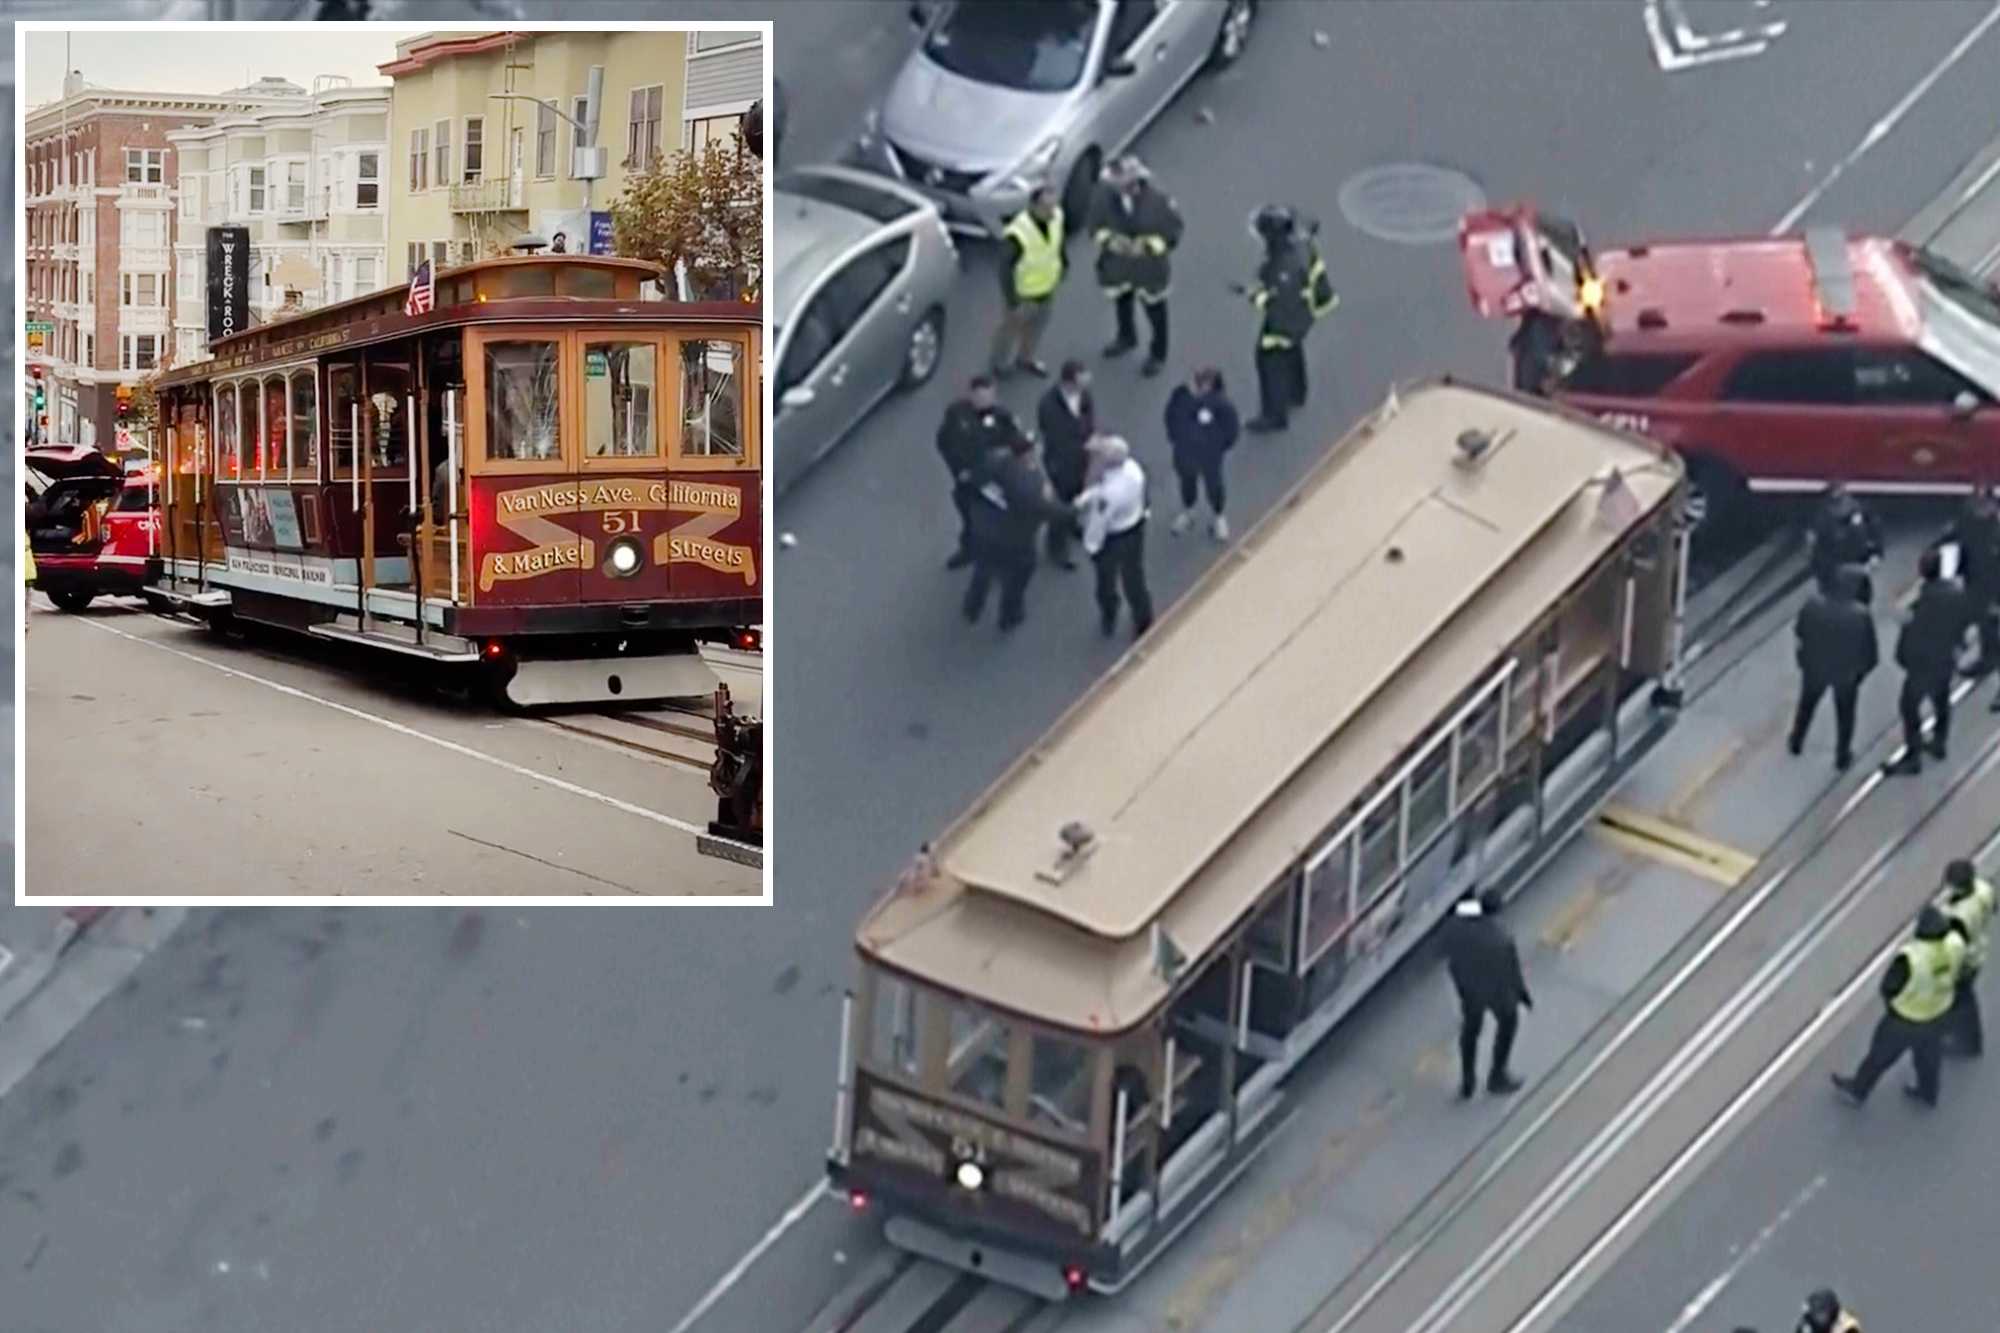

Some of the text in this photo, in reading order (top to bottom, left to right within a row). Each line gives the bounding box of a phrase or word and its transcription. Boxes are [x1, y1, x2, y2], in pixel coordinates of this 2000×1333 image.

[222, 243, 235, 299] WRECK
[502, 494, 537, 513] Van
[540, 487, 587, 509] Ness
[649, 483, 738, 509] California
[602, 510, 642, 534] 51
[493, 543, 585, 574] & Market
[669, 538, 744, 566] Streets
